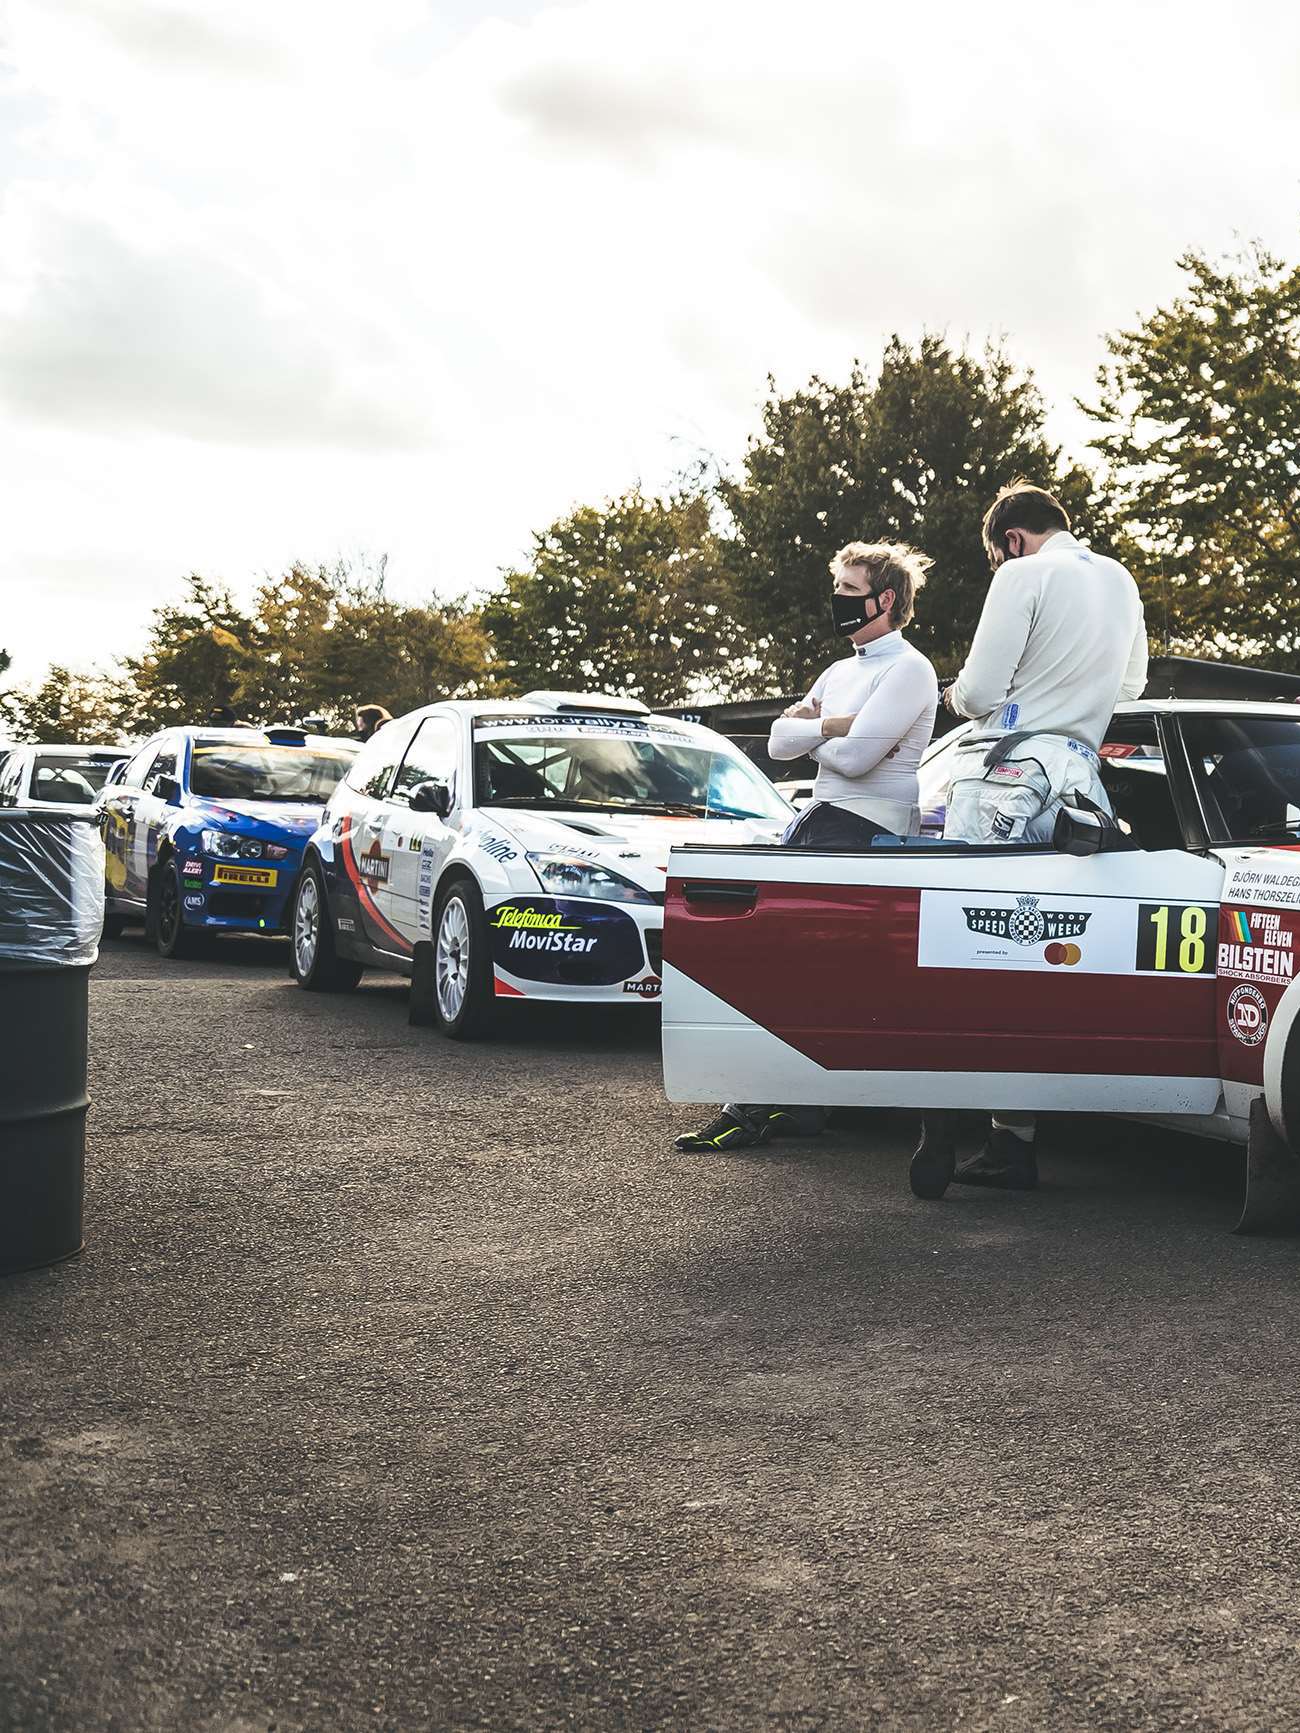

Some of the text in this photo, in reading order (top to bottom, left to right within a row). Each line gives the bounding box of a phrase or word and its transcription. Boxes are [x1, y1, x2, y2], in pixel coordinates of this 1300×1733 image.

[217, 867, 271, 884] PIRELLI
[360, 856, 390, 882] MARTINI
[1228, 887, 1252, 900] HANS
[969, 909, 1086, 921] GOOD WOOD
[1250, 912, 1280, 930] FIFTEEN
[971, 918, 1081, 937] SPEED WEEK
[508, 930, 598, 953] MoviStar
[1150, 906, 1207, 973] 18
[1264, 930, 1293, 948] ELEVEN
[1217, 943, 1294, 977] BILSTEIN
[1218, 968, 1292, 985] SHOCK ABSORBERS
